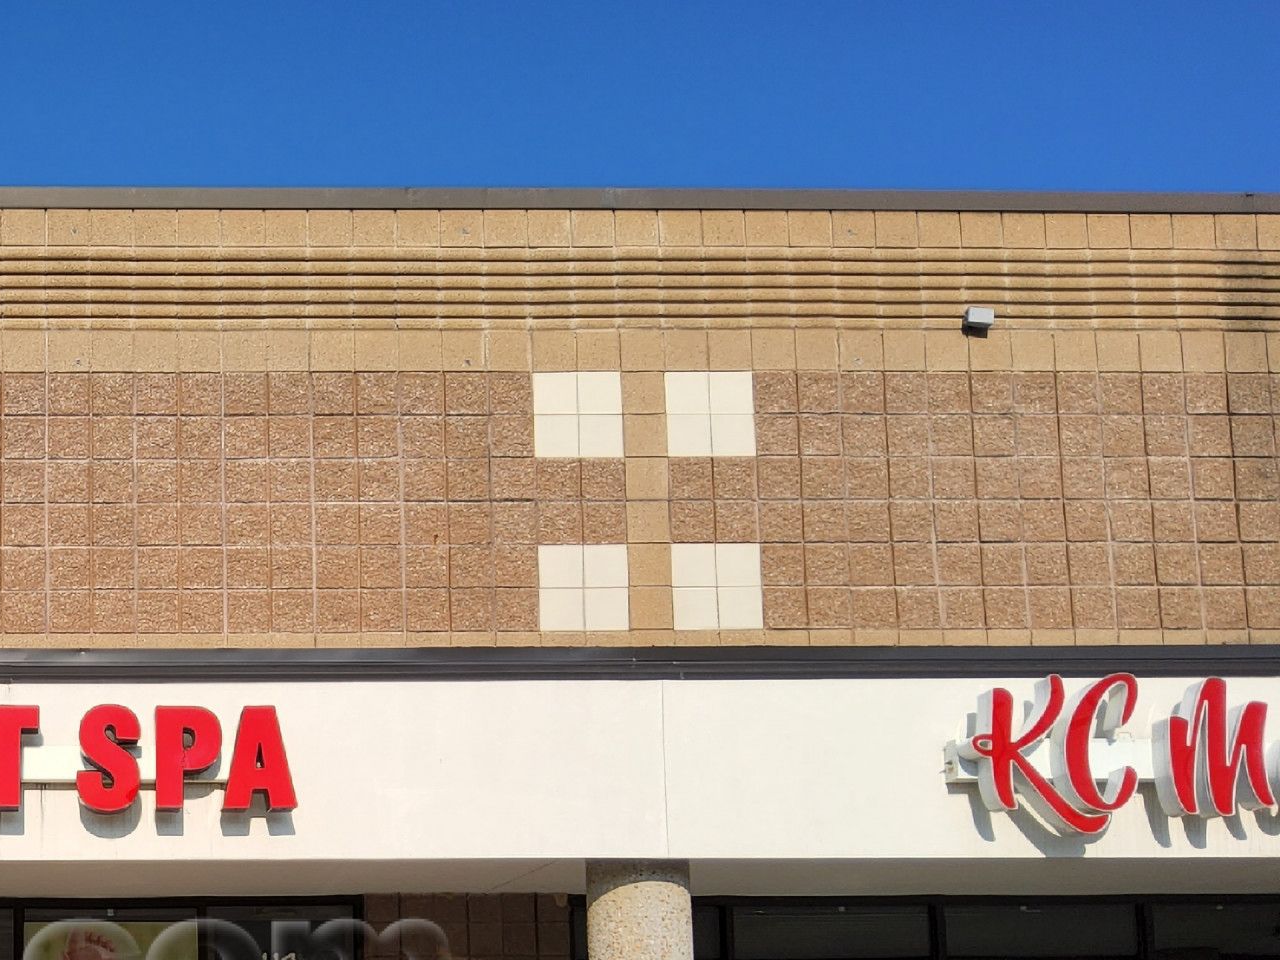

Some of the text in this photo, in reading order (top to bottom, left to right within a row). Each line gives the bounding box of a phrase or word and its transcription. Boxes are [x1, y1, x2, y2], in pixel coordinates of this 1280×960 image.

[76, 703, 299, 814] SPA
[972, 672, 1280, 834] KC M
